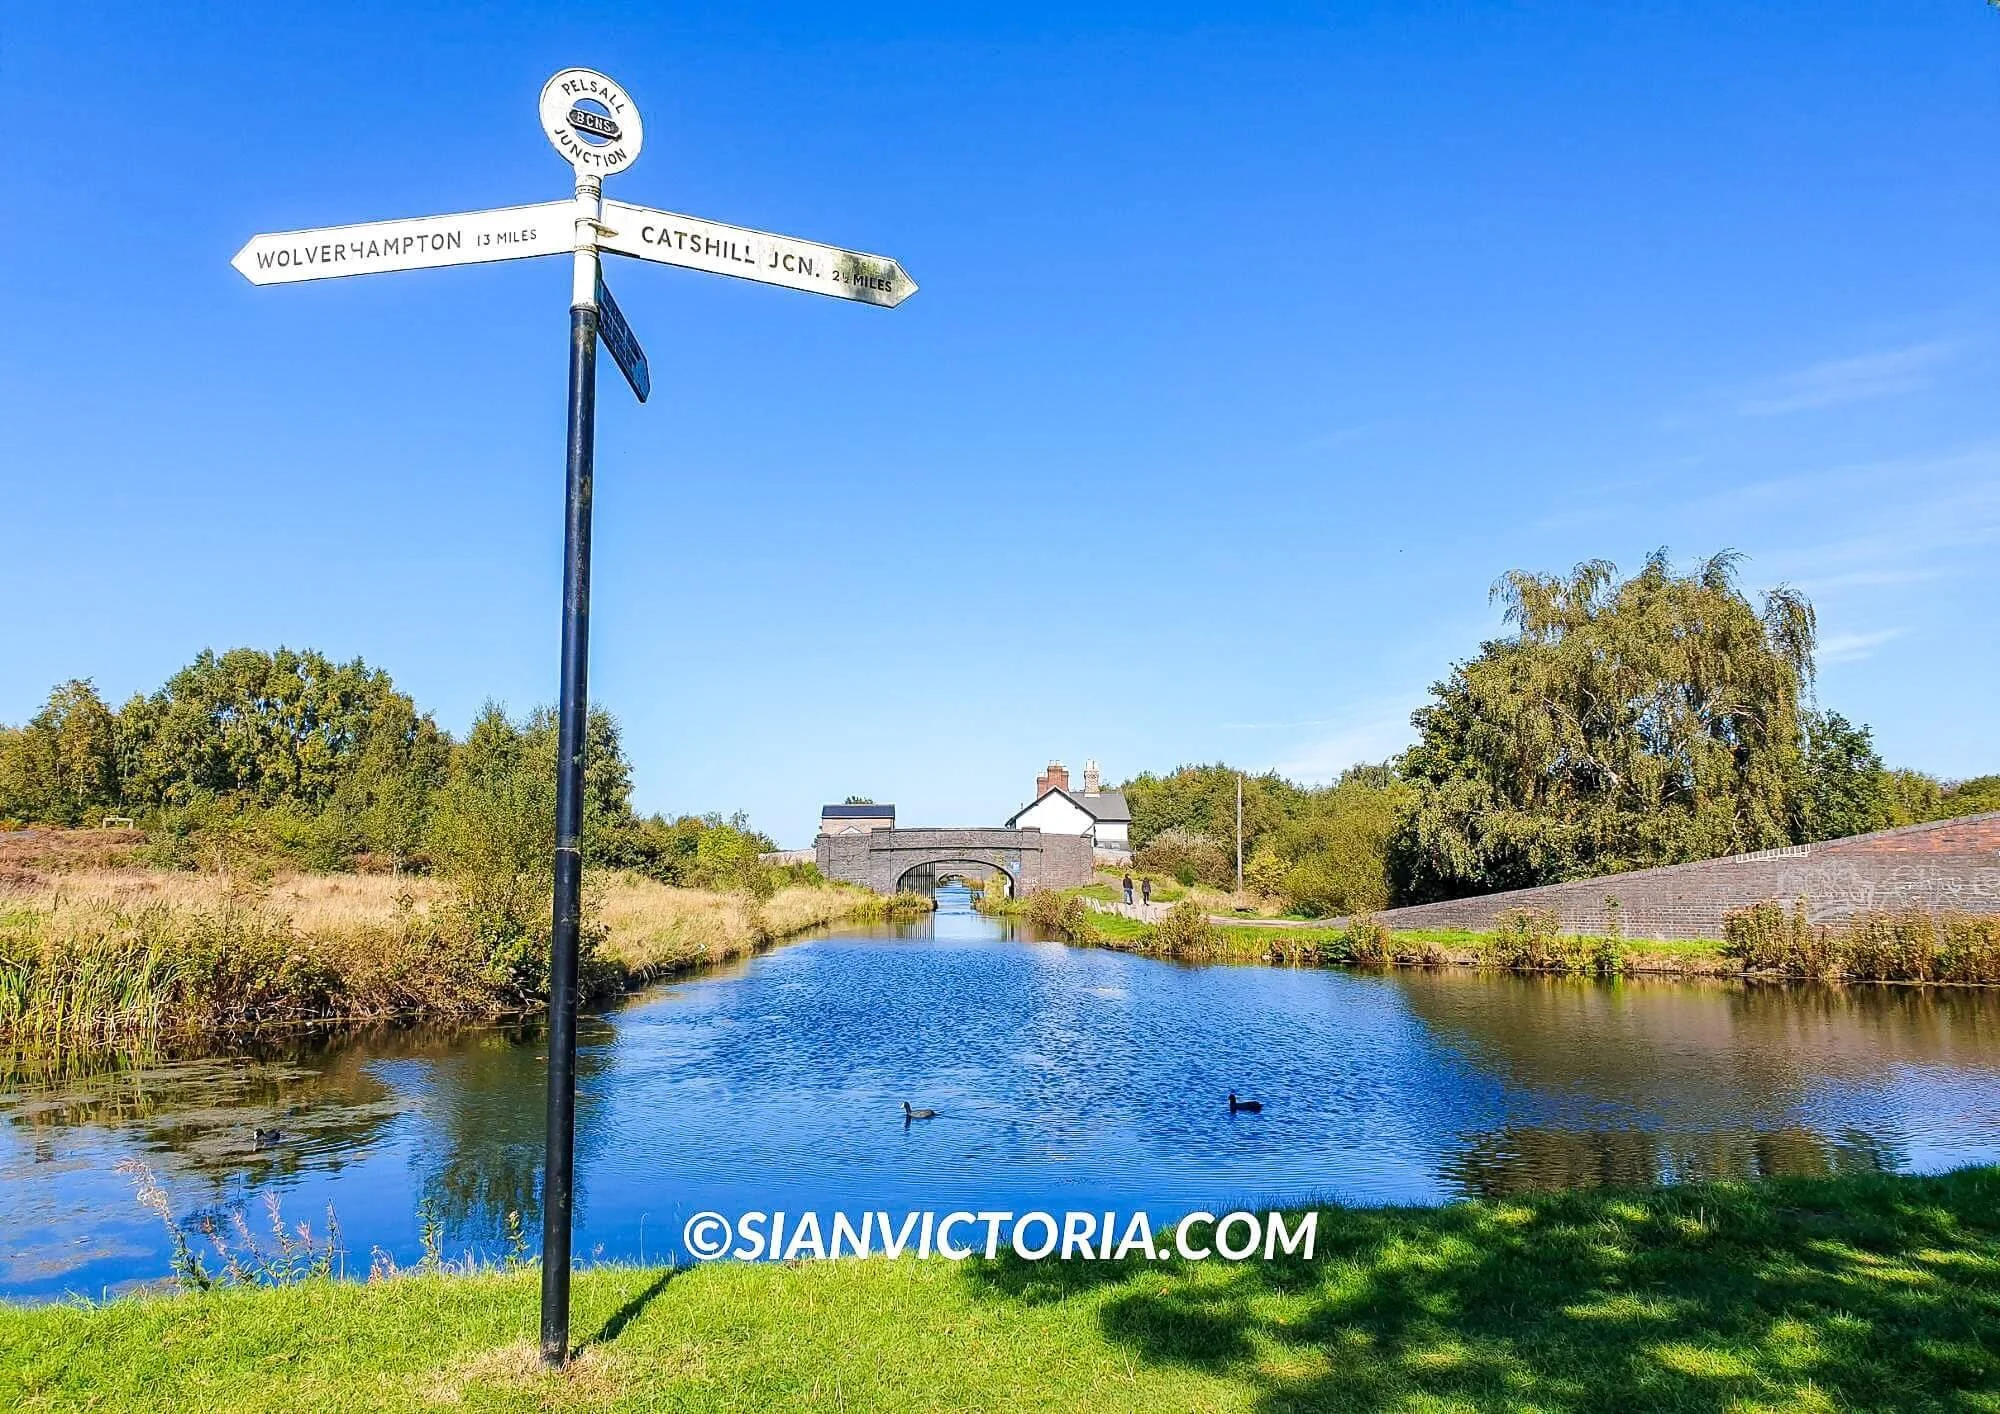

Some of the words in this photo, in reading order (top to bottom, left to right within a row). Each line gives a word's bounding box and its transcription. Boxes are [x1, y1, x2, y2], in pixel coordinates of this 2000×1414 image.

[561, 79, 625, 114] PELSALL
[577, 111, 612, 132] BCNS
[554, 128, 628, 167] JUNCTION
[257, 231, 461, 269] WOLVERHAMPTON
[477, 234, 491, 247] 13
[497, 229, 538, 245] MILES
[641, 226, 755, 264] CATSHILL
[769, 251, 820, 278] JCN.
[853, 273, 892, 293] MILES
